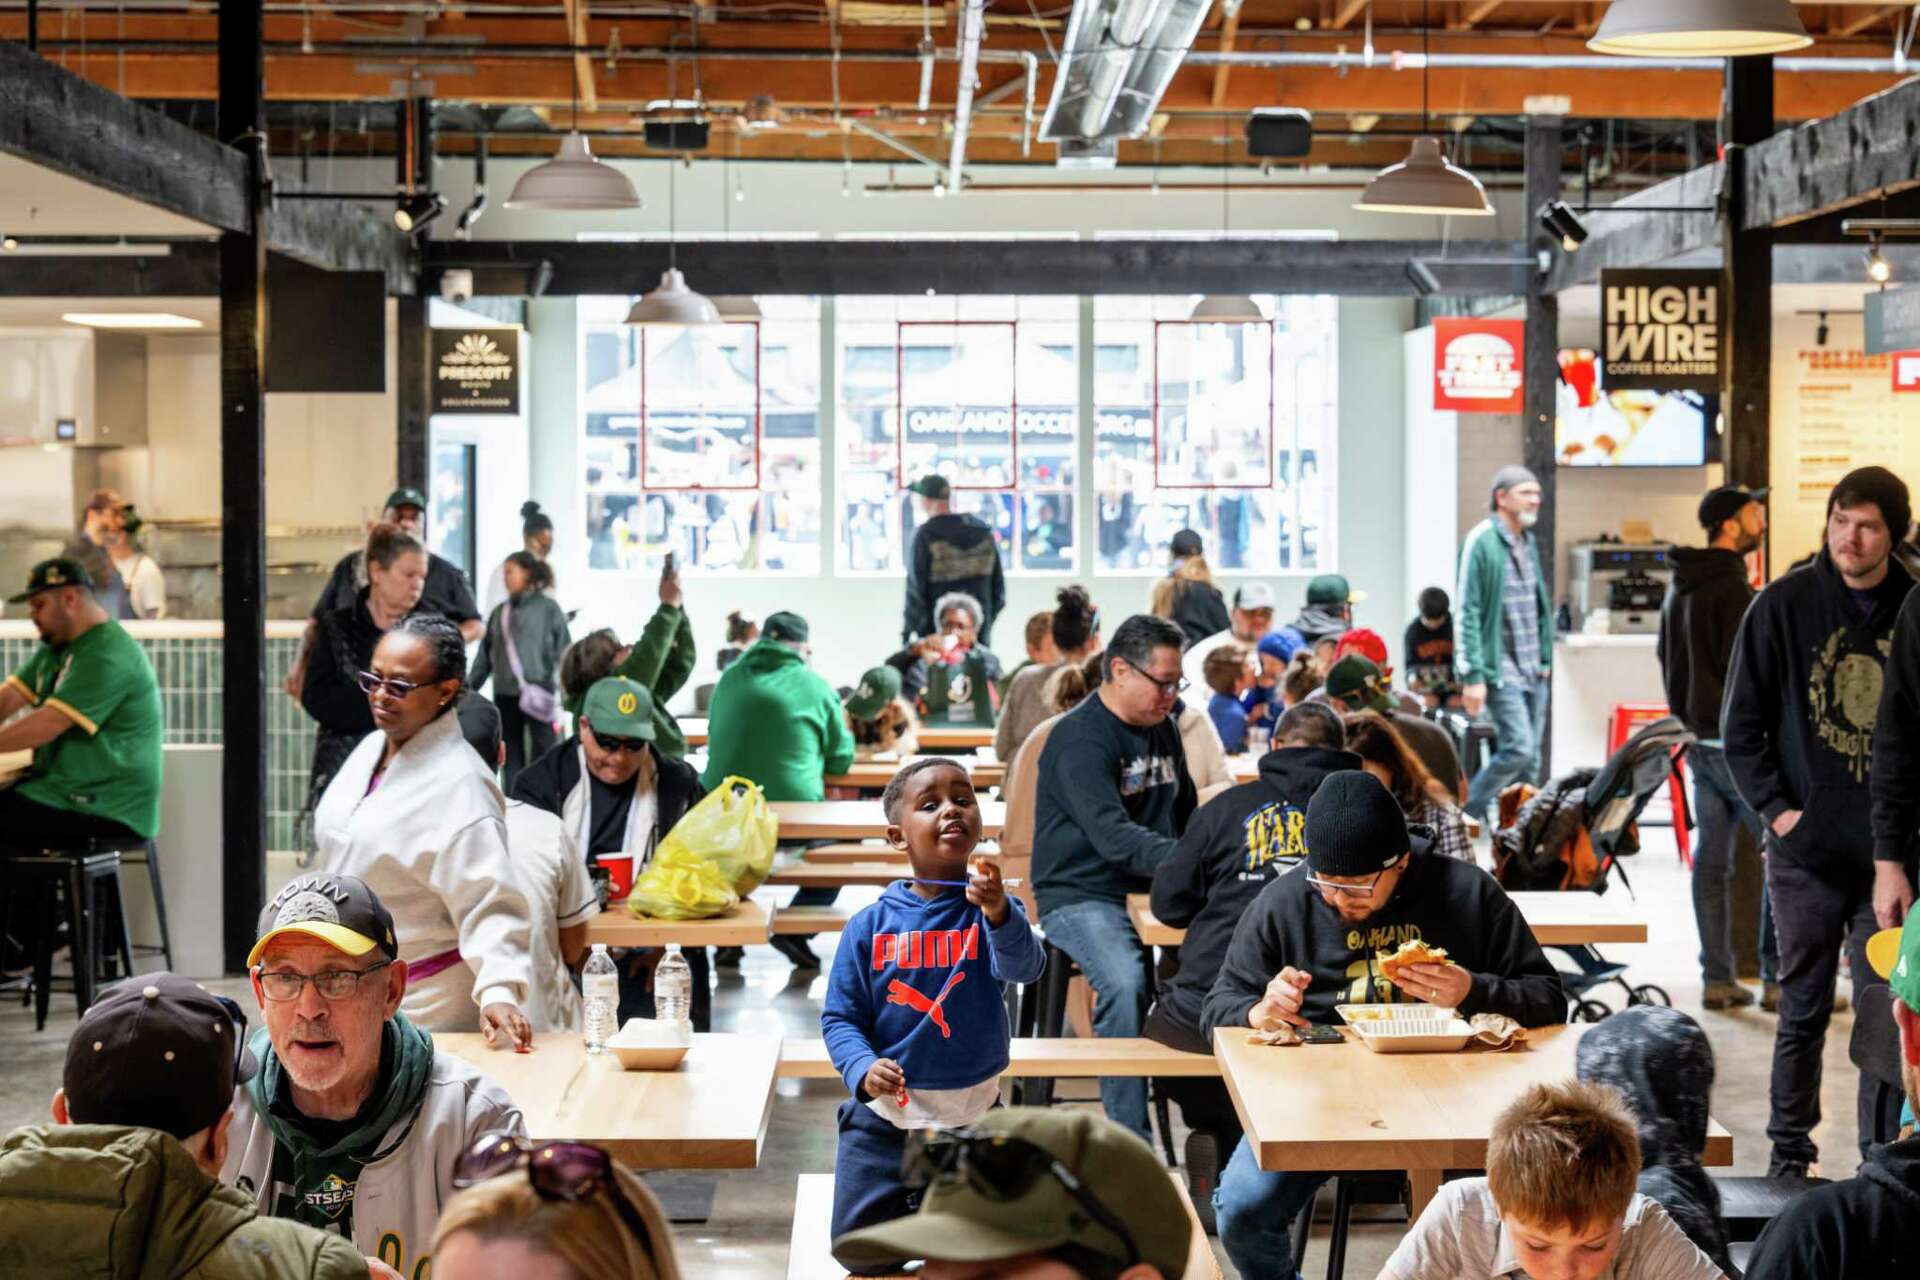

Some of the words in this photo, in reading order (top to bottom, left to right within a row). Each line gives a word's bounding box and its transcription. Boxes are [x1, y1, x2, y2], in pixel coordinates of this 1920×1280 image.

[1606, 286, 1717, 324] HIGH
[1606, 323, 1717, 361] WIRE
[438, 365, 512, 380] PRESCOTT
[1606, 362, 1653, 375] COFFEE
[1654, 361, 1717, 375] ROASTERS
[269, 876, 350, 913] TOWN
[872, 922, 979, 971] PUMA
